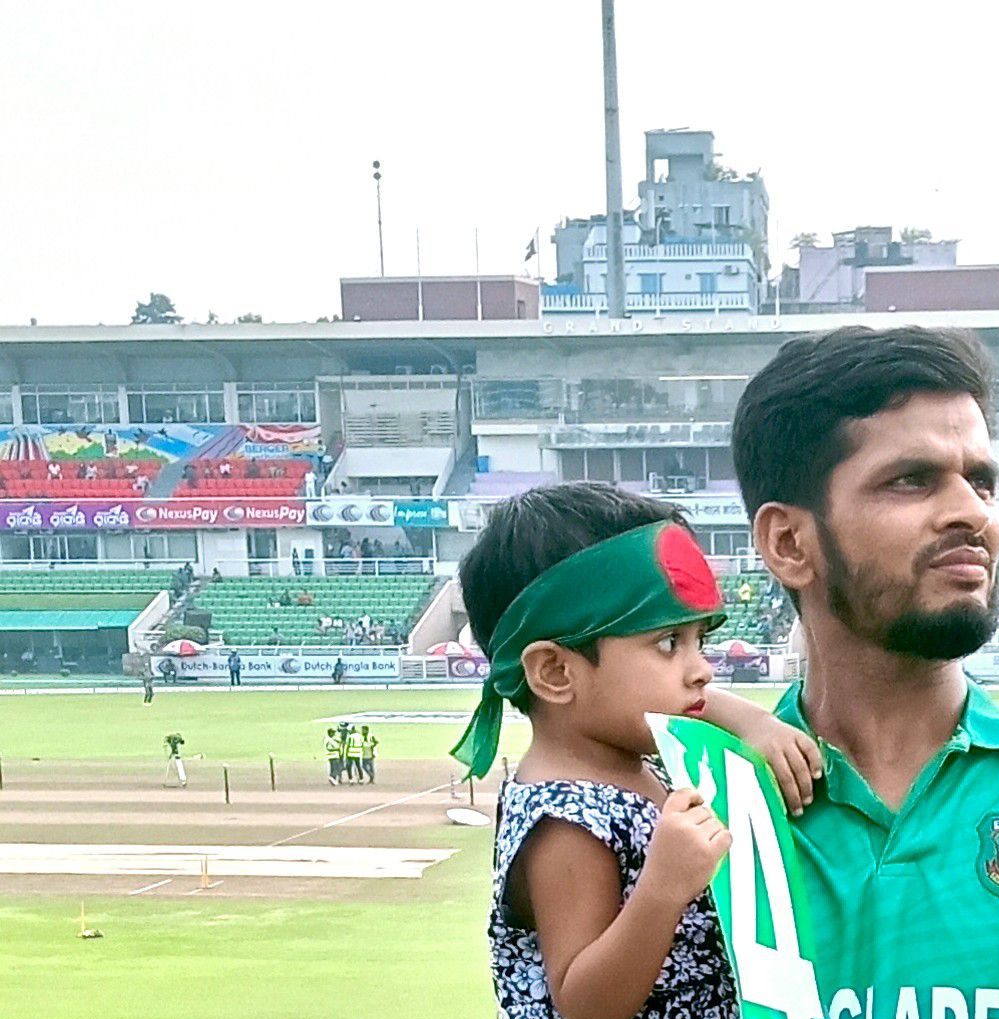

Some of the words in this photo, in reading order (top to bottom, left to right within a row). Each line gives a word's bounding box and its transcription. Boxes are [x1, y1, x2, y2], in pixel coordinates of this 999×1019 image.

[543, 320, 644, 335] GRAND
[682, 319, 781, 333] STAND
[158, 507, 218, 523] NexusPay
[246, 506, 305, 523] NexusPay
[181, 662, 245, 671] Dutch-Bana
[248, 662, 271, 671] Bank
[304, 661, 369, 672] Dutch-angla
[372, 661, 396, 671] Bank
